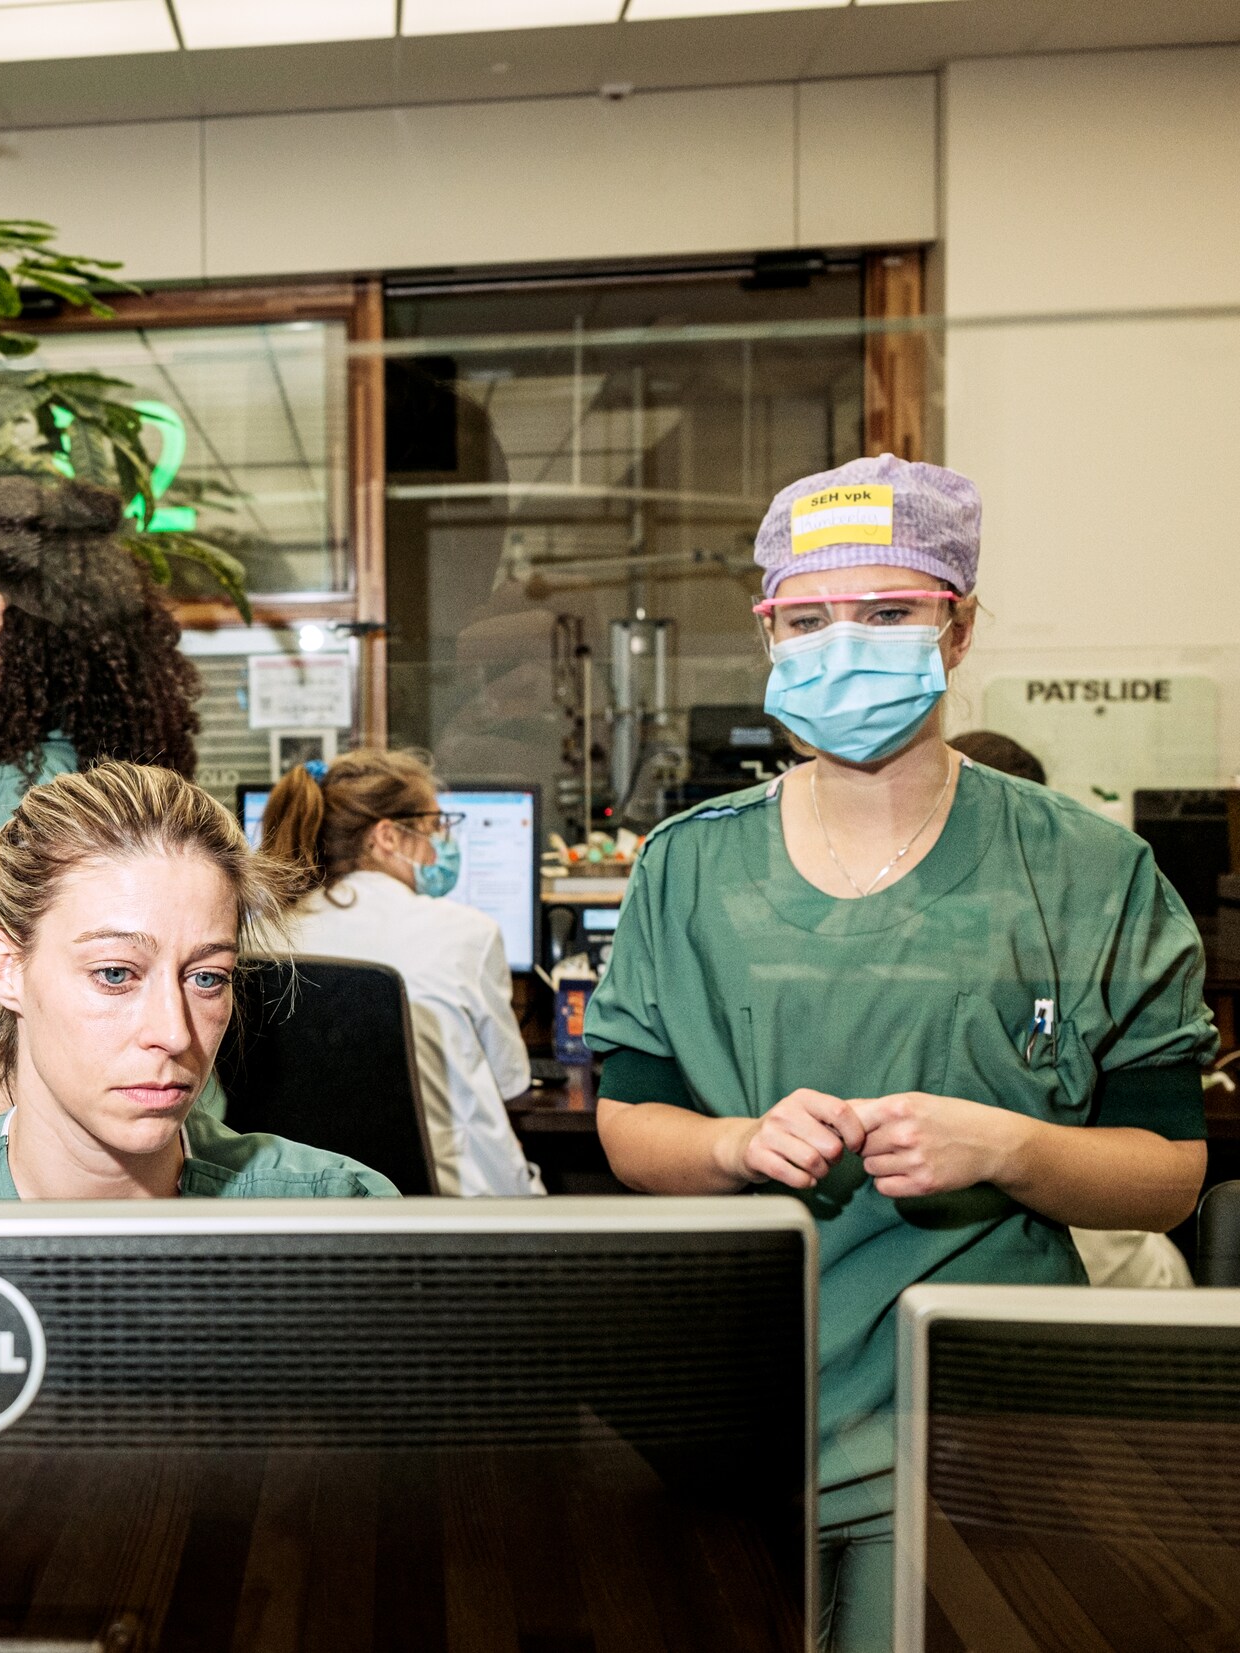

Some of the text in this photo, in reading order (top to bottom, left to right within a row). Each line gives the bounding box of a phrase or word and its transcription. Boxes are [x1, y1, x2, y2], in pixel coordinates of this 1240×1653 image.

[811, 490, 872, 507] SEH vpk
[1026, 679, 1172, 703] PATSLIDE
